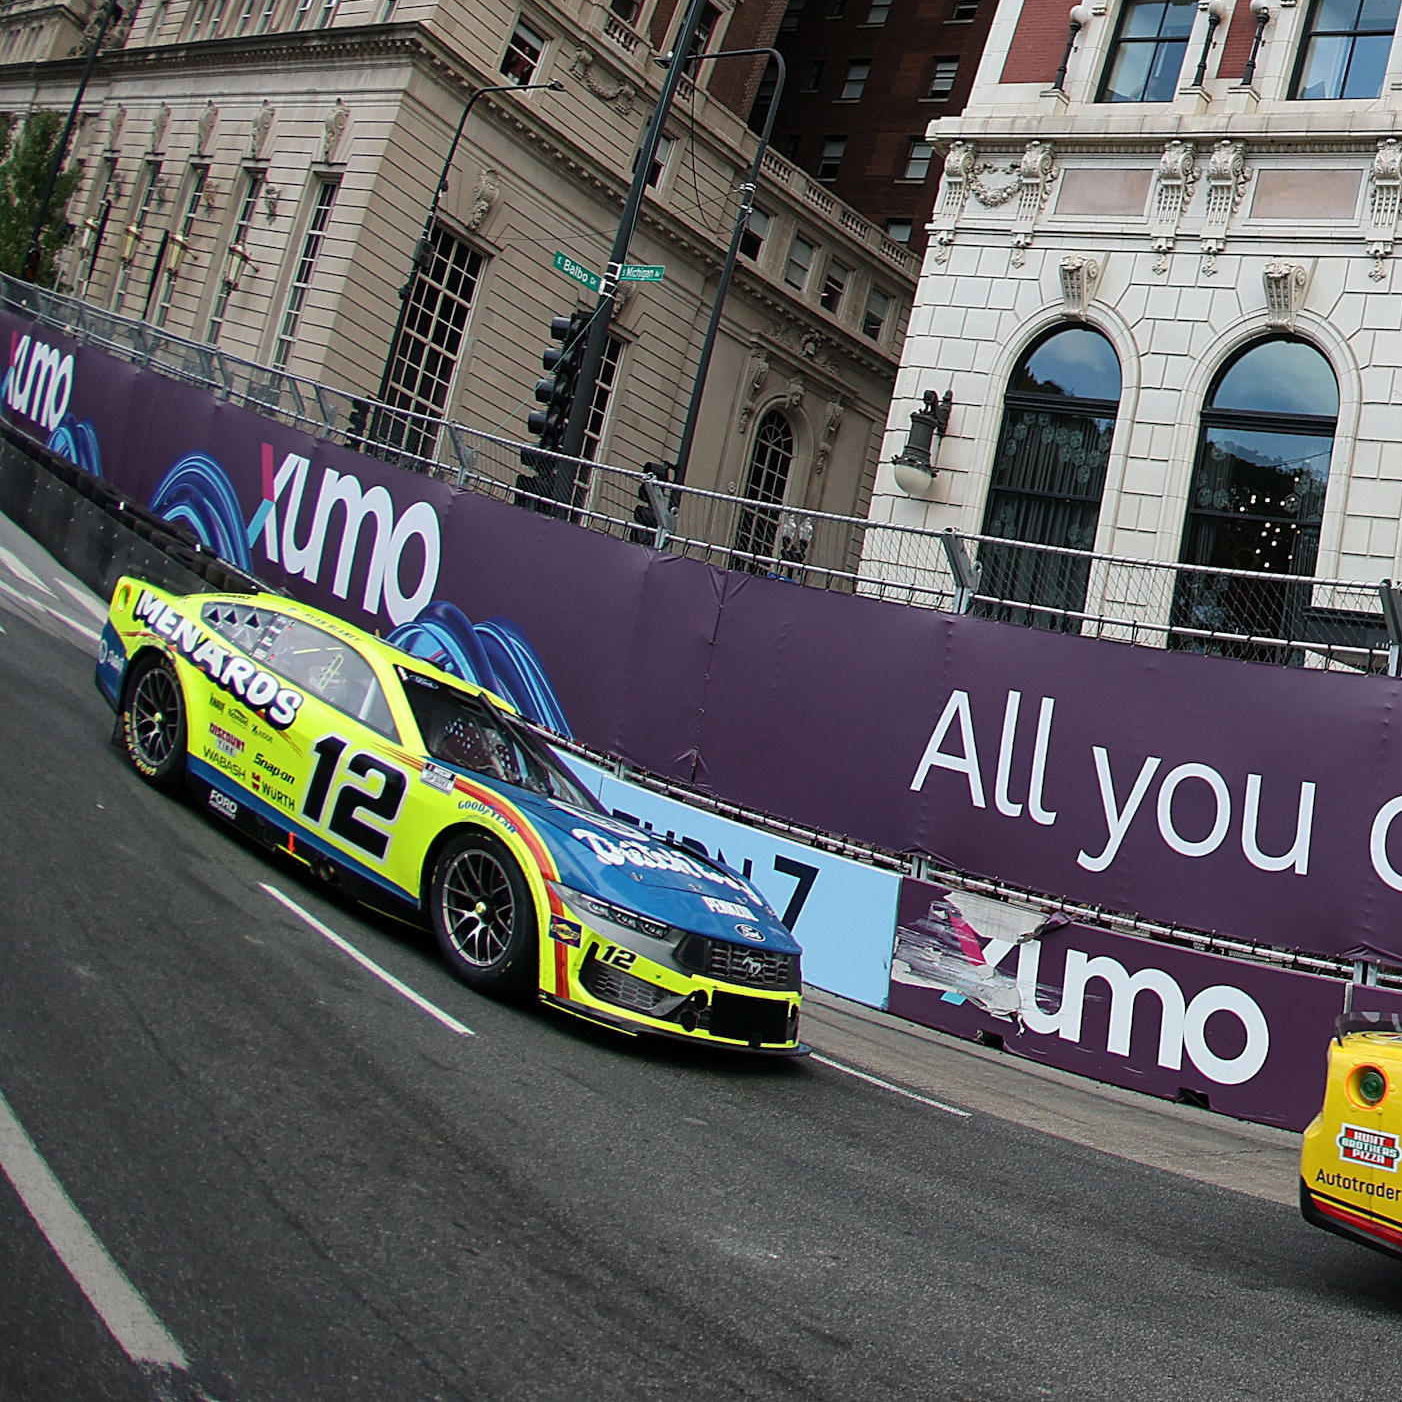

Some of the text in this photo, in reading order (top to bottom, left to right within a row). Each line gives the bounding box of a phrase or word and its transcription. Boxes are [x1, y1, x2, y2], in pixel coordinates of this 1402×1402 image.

[563, 258, 588, 282] Balbo
[589, 277, 597, 286] Dr
[626, 267, 654, 281] Michigan
[0, 330, 75, 432] xumo
[247, 441, 441, 627] xumo
[134, 589, 304, 729] MENARDS
[209, 722, 246, 752] DISCOUNT
[203, 745, 246, 781] WABASH
[252, 752, 296, 785] Snap-on
[302, 732, 409, 864] 12
[910, 689, 1057, 825] All
[1076, 746, 1316, 874] you
[210, 788, 238, 814] FORD
[457, 799, 519, 835] GOODYEAR
[773, 853, 820, 934] 7
[550, 923, 581, 940] SUNOCO
[601, 944, 638, 971] 12
[1340, 1137, 1398, 1160] BROTHERS
[1353, 1130, 1387, 1147] HUNT
[1351, 1149, 1386, 1165] PIZZA
[1315, 1168, 1402, 1202] Autotrader
